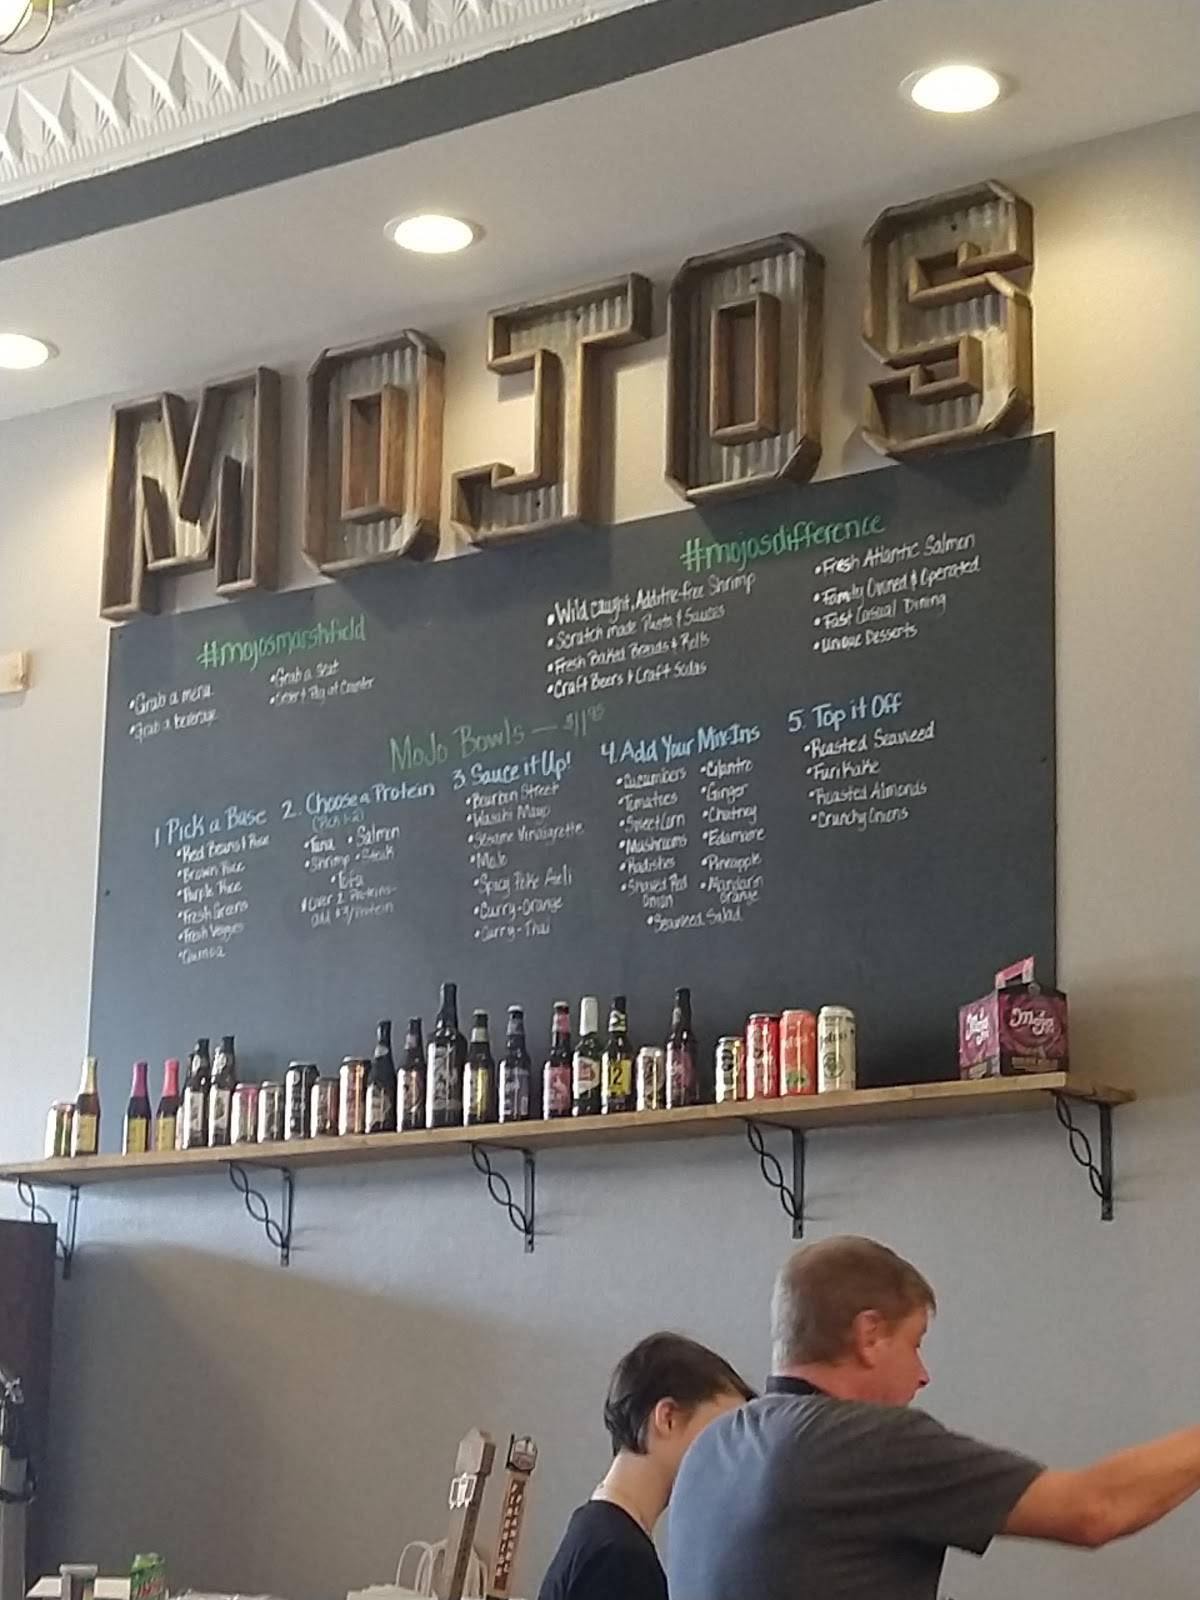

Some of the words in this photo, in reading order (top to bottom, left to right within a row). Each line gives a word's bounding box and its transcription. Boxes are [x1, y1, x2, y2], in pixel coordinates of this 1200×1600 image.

[97, 180, 1035, 621] MOJOS
[680, 514, 884, 571] #mojosdifference
[821, 555, 860, 577] Fresh
[863, 543, 919, 568] Atlantic
[923, 532, 976, 556] Salmon
[708, 572, 756, 595] Shrimp
[821, 583, 864, 606] Family
[866, 573, 907, 599] Owned
[920, 555, 981, 588] Operated
[855, 599, 897, 625] Casual
[902, 593, 947, 616] Dining
[197, 611, 366, 671] #mojosmarshfield
[555, 625, 603, 651] Scratch
[684, 603, 726, 627] Sauces
[864, 623, 918, 645] Desserts
[554, 656, 586, 675] Fresh
[630, 641, 670, 659] Breads
[554, 673, 588, 699] Craft
[590, 671, 623, 688] Beers
[635, 664, 671, 684] Craft
[135, 691, 166, 715] Grab
[169, 691, 179, 705] a
[811, 703, 847, 731] Top
[850, 696, 868, 719] it
[872, 692, 902, 717] Off
[452, 717, 525, 759] Bowls
[620, 740, 659, 763] Add
[661, 734, 695, 763] Your
[809, 734, 868, 759] Roasted
[873, 720, 936, 748] Seaweed
[471, 762, 520, 785] Sauce
[524, 754, 540, 775] it
[541, 750, 571, 780] Up!
[706, 757, 753, 779] Cilantro
[305, 791, 358, 815] Choose
[359, 793, 370, 804] a
[372, 781, 435, 801] Protein
[706, 782, 748, 804] Ginger
[870, 779, 927, 800] Almonds
[165, 814, 205, 845] Pick
[209, 818, 222, 834] a
[224, 805, 268, 830] Base
[356, 823, 400, 848] Salmon
[818, 808, 867, 832] Crunchy
[181, 844, 205, 863] Red
[310, 834, 336, 853] Tuna
[626, 834, 688, 855] Mushrooms
[309, 853, 351, 874] Shrimp
[707, 852, 762, 872] Pineapple
